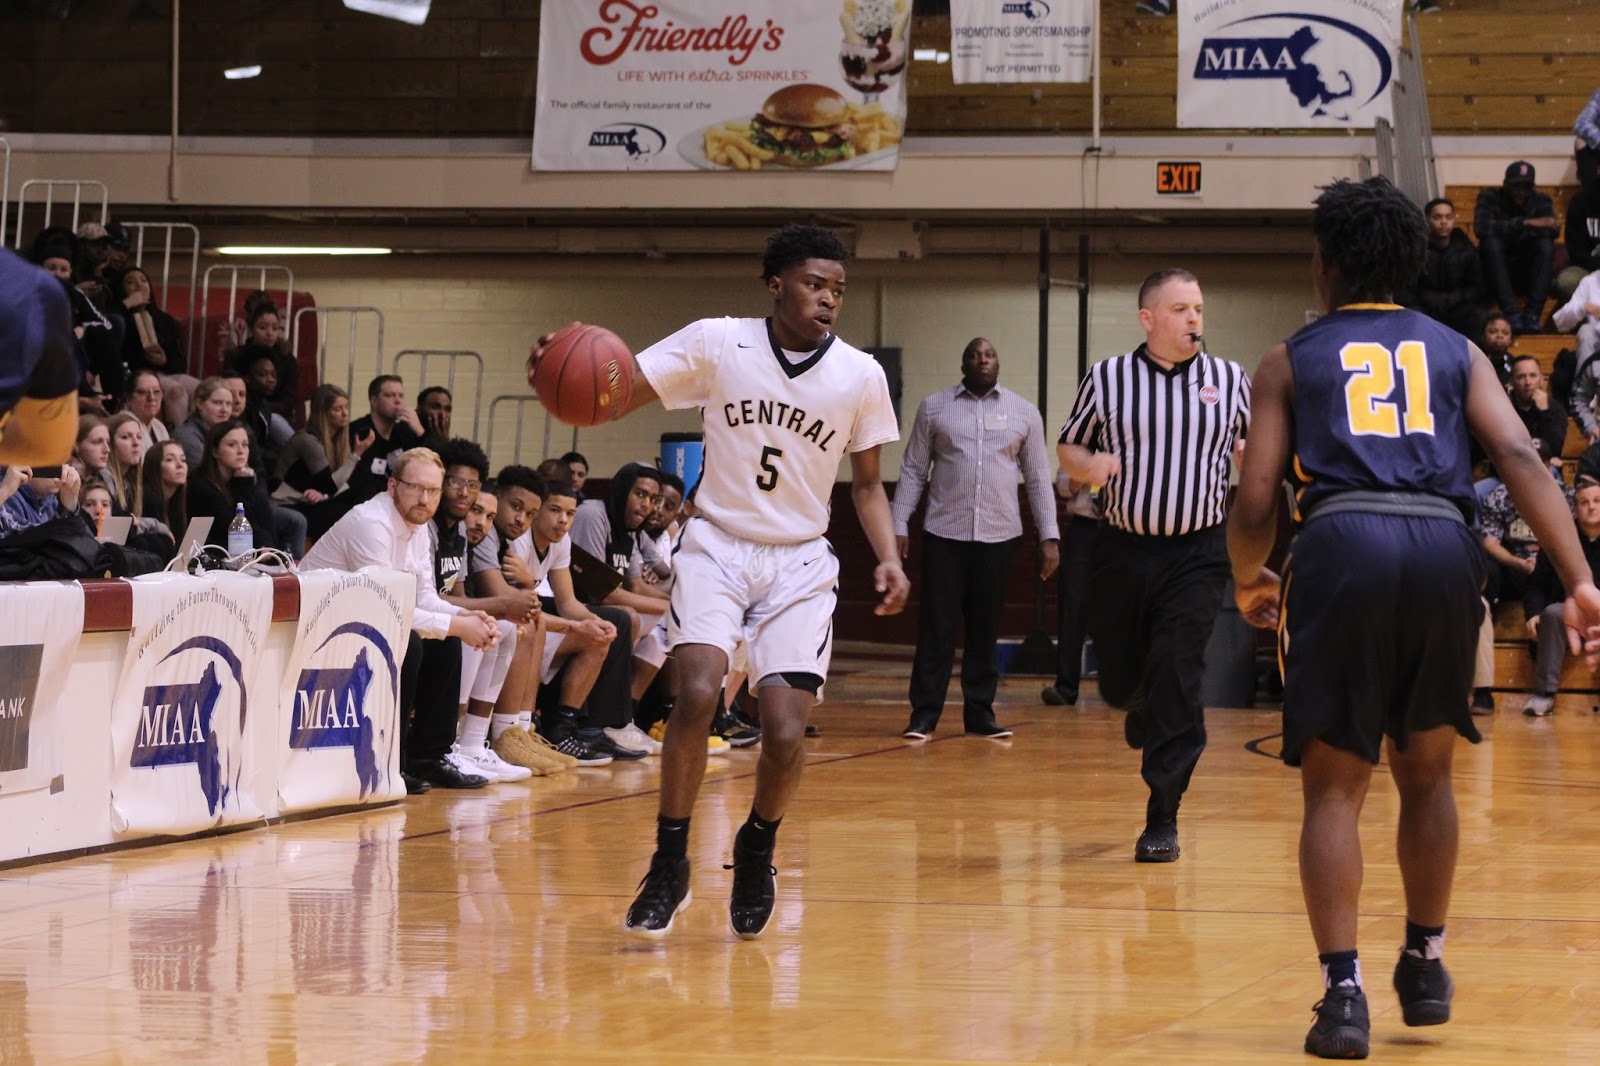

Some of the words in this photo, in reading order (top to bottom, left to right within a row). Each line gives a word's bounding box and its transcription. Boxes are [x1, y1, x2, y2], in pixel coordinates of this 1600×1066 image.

[580, 0, 785, 66] Friendly's
[955, 27, 1011, 38] PROMOTING
[1012, 26, 1091, 38] SPORTSMANSHIP
[986, 65, 1004, 73] NOT
[1007, 65, 1061, 74] PERMITTED
[1203, 47, 1297, 71] MIAA
[617, 71, 644, 82] LIFE
[648, 71, 684, 82] WITH
[688, 68, 733, 82] extra
[736, 70, 809, 82] SPRINKLES
[551, 101, 568, 109] The
[570, 101, 601, 110] official
[603, 101, 631, 111] family
[633, 101, 681, 110] restaurant
[683, 101, 693, 110] of
[696, 101, 712, 110] the
[592, 134, 630, 145] MIAA
[1158, 165, 1200, 192] EXIT
[1339, 340, 1436, 438] 21
[724, 400, 838, 452] CENTRAL
[756, 446, 783, 492] 5
[331, 581, 340, 598] the
[341, 576, 361, 590] Future
[362, 573, 387, 600] Through
[176, 598, 187, 615] the
[188, 590, 210, 607] Future
[211, 587, 237, 616] Through
[0, 696, 27, 720] ANK
[297, 688, 360, 730] MIAA
[137, 701, 206, 748] MIAA
